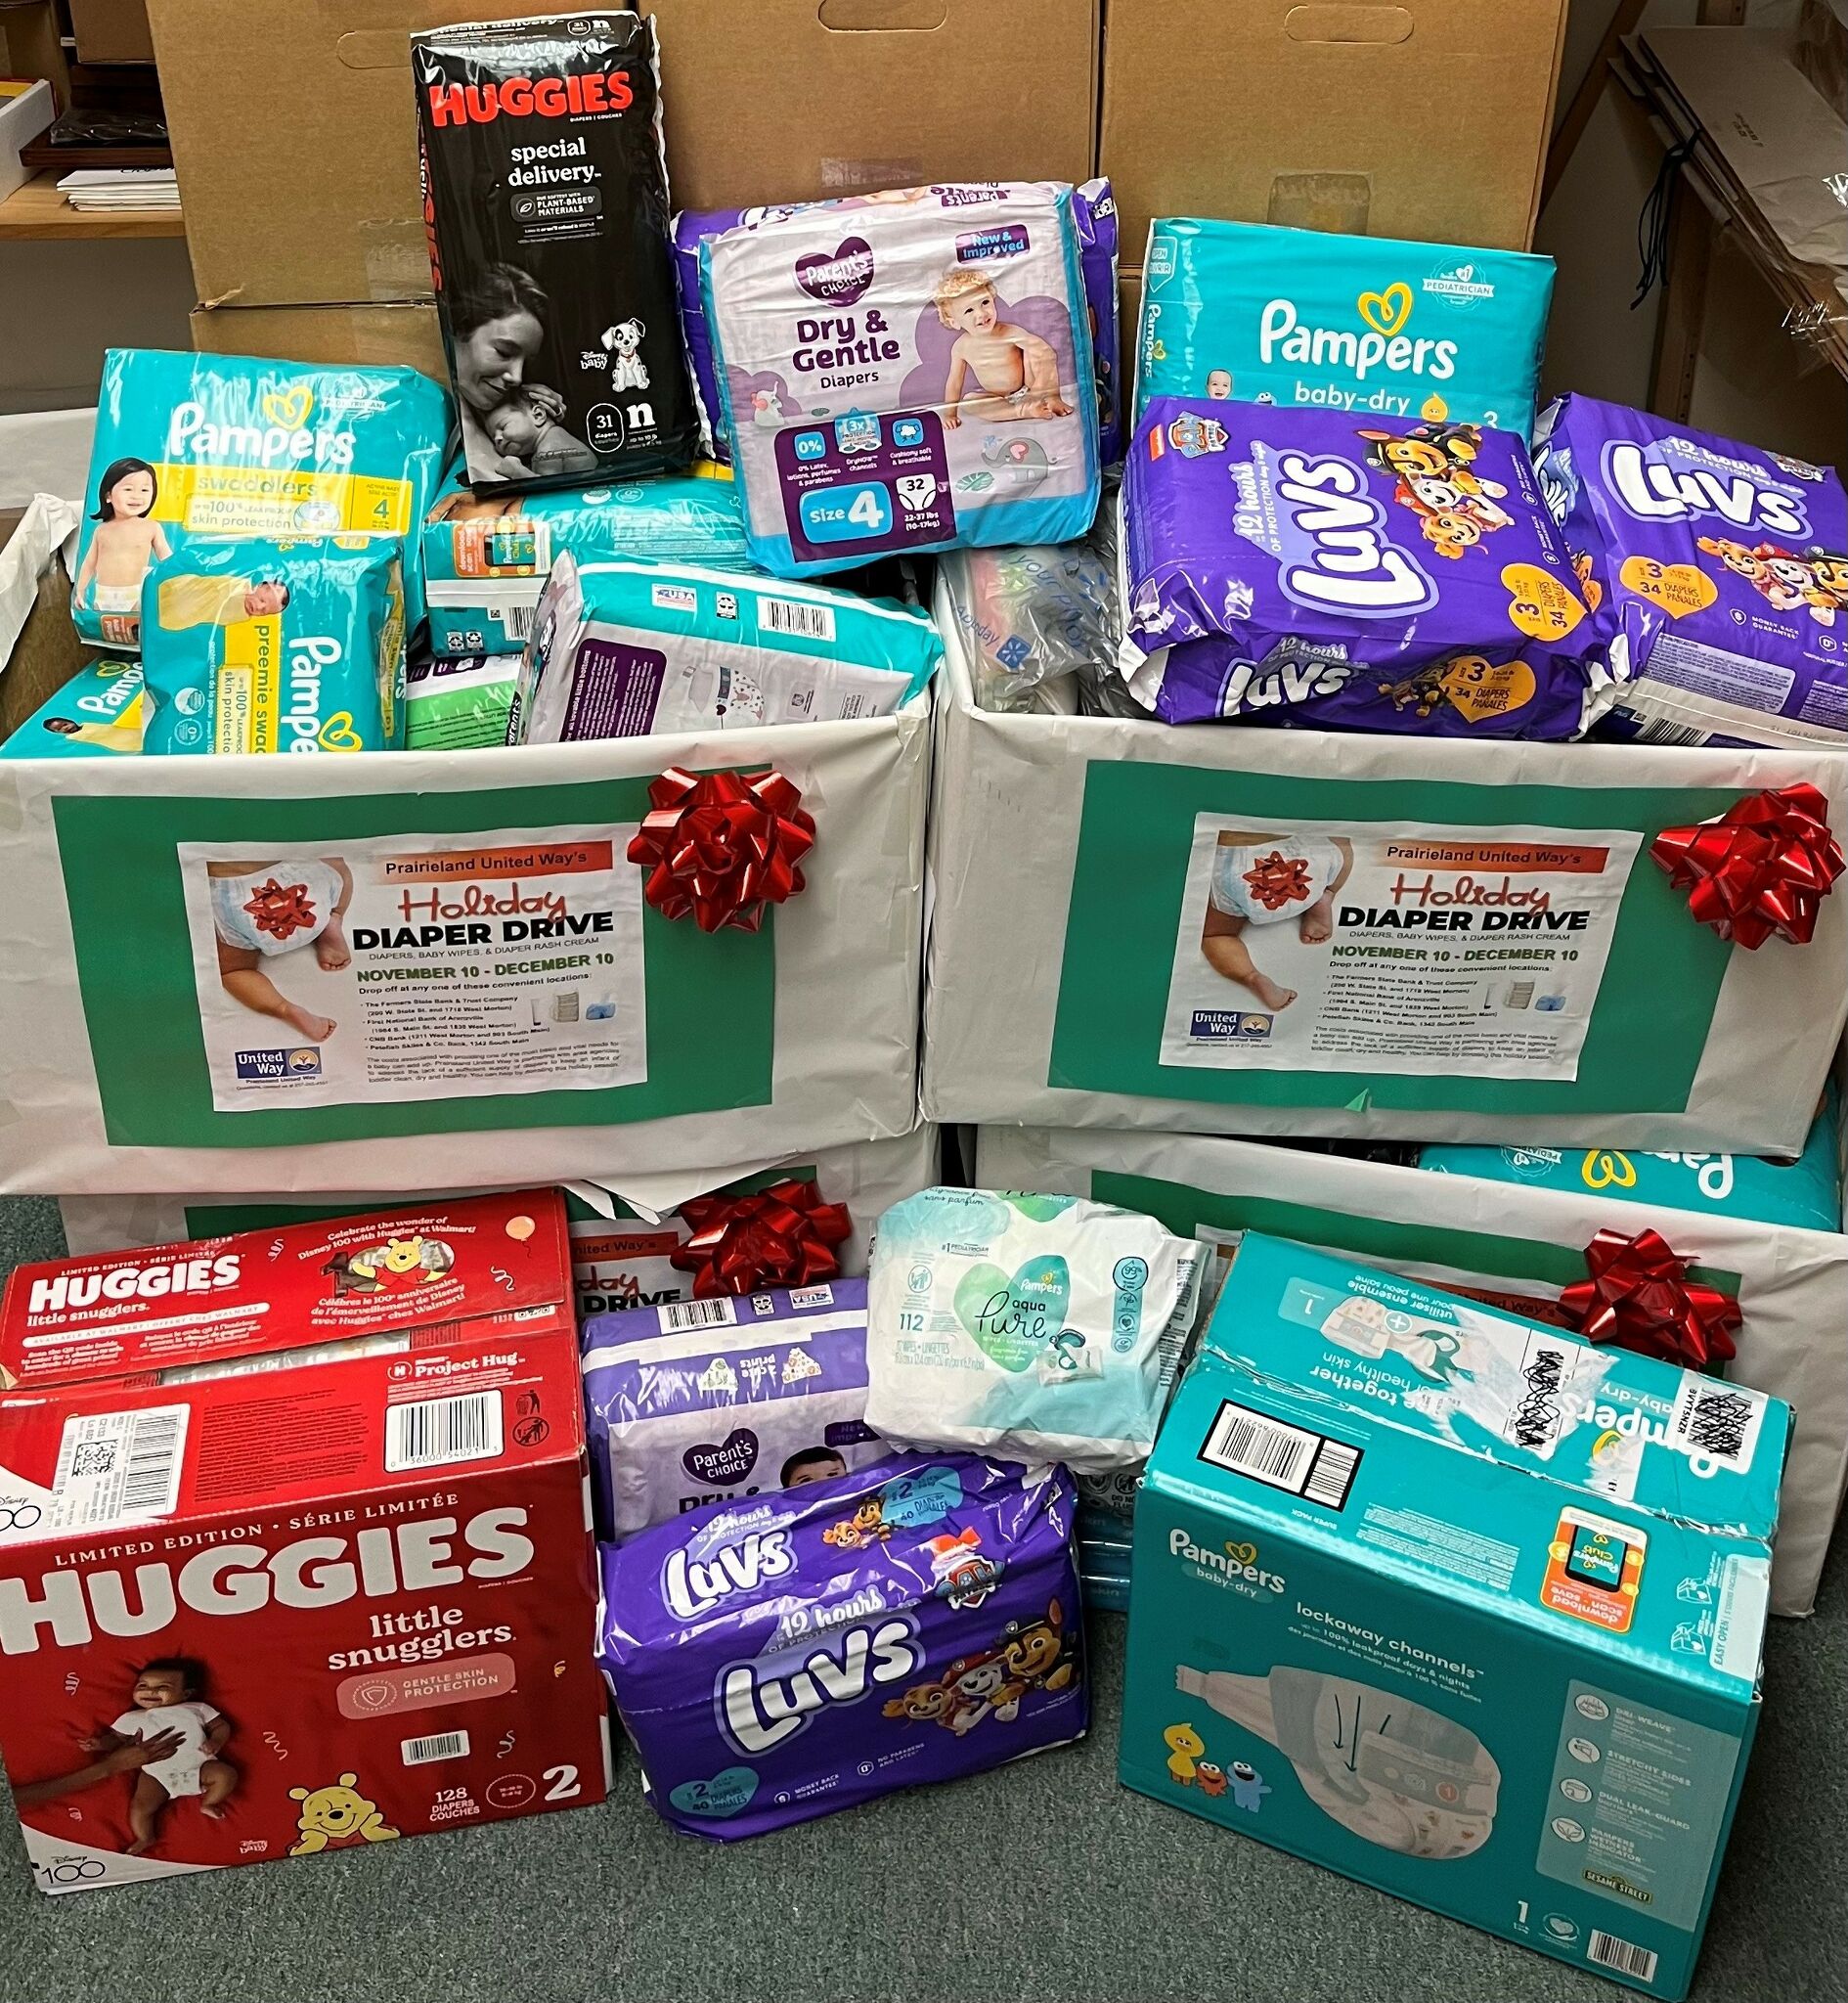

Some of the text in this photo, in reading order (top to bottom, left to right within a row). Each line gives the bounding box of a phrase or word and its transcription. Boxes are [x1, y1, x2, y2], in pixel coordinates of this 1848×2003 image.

[429, 70, 634, 127] HUGGIES
[511, 137, 587, 164] special
[538, 205, 584, 216] MATERIALS
[963, 238, 1025, 259] Improved
[972, 231, 1012, 246] New &
[806, 248, 869, 287] Parent's
[819, 274, 867, 297] CHOICE
[1426, 279, 1491, 296] PEDIATRICIAN
[797, 309, 890, 344] Dry &
[1148, 304, 1162, 378] Pampers
[1259, 298, 1458, 380] Pampers
[580, 355, 607, 370] baby
[792, 335, 902, 373] Gentle
[819, 370, 880, 390] Diapers
[1295, 381, 1410, 414] baby-dry
[596, 415, 613, 428] 31
[627, 403, 656, 428] n
[171, 401, 357, 467] Pampers
[798, 439, 822, 454] 0%
[1670, 437, 1698, 455] 12
[1677, 452, 1751, 479] PROTECTION
[198, 474, 320, 497] swaddlers
[905, 478, 926, 492] 32
[1236, 465, 1259, 511] hours
[1613, 445, 1801, 534] Luvs
[374, 499, 389, 518] 4
[810, 490, 884, 529] Size 4
[192, 513, 291, 531] skin protection
[1279, 455, 1427, 606] Luvs
[1647, 562, 1662, 578] 3
[1640, 581, 1661, 596] 34
[1517, 603, 1539, 615] 3
[1550, 611, 1567, 628] 34
[1752, 615, 1799, 635] MONEY BACK
[1299, 642, 1347, 659] hours
[255, 626, 273, 704] preemie
[1467, 662, 1486, 682] 3
[223, 671, 236, 695] skin
[1454, 688, 1510, 700] 34 DIAPERS
[385, 852, 588, 874] Prairieland United Way's
[1387, 846, 1581, 866] Prairieland United Way's
[398, 882, 566, 923] Holiday
[1390, 872, 1550, 917] Holiday
[1339, 906, 1591, 932] DIAPER DRIVE
[353, 912, 614, 950] DIAPER DRIVE
[1349, 931, 1394, 940] DIAPERS,
[1397, 932, 1422, 941] BABY
[369, 936, 600, 961] DIAPERS, BABY DIAPER RASH CREAM
[1332, 945, 1578, 961] NOVEMBER 10 DECEMBER 10
[357, 953, 614, 982] NOVEMBER 10 DECEMBER 10
[359, 987, 383, 996] Drop
[412, 985, 429, 994] any
[492, 977, 545, 989] convenient
[1195, 1013, 1237, 1023] United
[1210, 1023, 1236, 1035] Way
[239, 1051, 284, 1065] United
[256, 1062, 286, 1078] Way
[947, 1196, 985, 1206] parfum
[328, 1223, 375, 1240] Celebrate
[396, 1218, 433, 1227] wonder
[297, 1232, 375, 1260] Disney 100 with
[614, 1241, 657, 1252] Way's
[61, 1260, 141, 1276] LIMITED EDITION
[28, 1255, 240, 1313] HUGGIES
[430, 1284, 464, 1301] Disney
[1020, 1278, 1064, 1297] Pampers
[584, 1289, 681, 1313] DRIVE
[1012, 1298, 1046, 1313] aqua
[1346, 1279, 1409, 1308] ensemble
[1410, 1300, 1453, 1320] utiliser
[1410, 1291, 1430, 1306] une
[26, 1313, 66, 1327] little
[900, 1313, 924, 1332] 112
[974, 1290, 1046, 1339] Pure
[415, 1358, 479, 1378] Project
[1322, 1351, 1411, 1395] skin healthy
[1309, 1365, 1398, 1405] together
[693, 1440, 753, 1471] Parent's
[707, 1459, 749, 1479] CHOICE
[900, 1482, 913, 1498] 2
[55, 1491, 460, 1566] LIMITED EDITION SÉRIE LIMITÉE
[1169, 1528, 1286, 1594] Pampers
[0, 1506, 535, 1656] HUGGIES
[667, 1531, 790, 1618] Luvs
[1196, 1566, 1257, 1598] baby-dry
[780, 1587, 883, 1640] 12 hours
[1551, 1594, 1619, 1625] download
[370, 1605, 463, 1638] little
[1297, 1601, 1385, 1646] lockaway
[329, 1625, 512, 1670] snugglers
[1713, 1619, 1729, 1666] EASY OPEN
[403, 1669, 484, 1688] GENTLE SKIN
[405, 1674, 499, 1698] PROTECTION
[726, 1620, 914, 1753] Luvs
[1438, 1672, 1471, 1690] nights
[543, 1764, 581, 1801] 2
[693, 1783, 709, 1798] 2
[431, 1799, 475, 1813] DIAPERS
[435, 1787, 467, 1803] 128
[1599, 1791, 1624, 1806] DUAL
[429, 1806, 480, 1822] COUCHES
[41, 1861, 106, 1884] 100
[1587, 1871, 1616, 1889] SESAME
[1619, 1884, 1649, 1902] STREET
